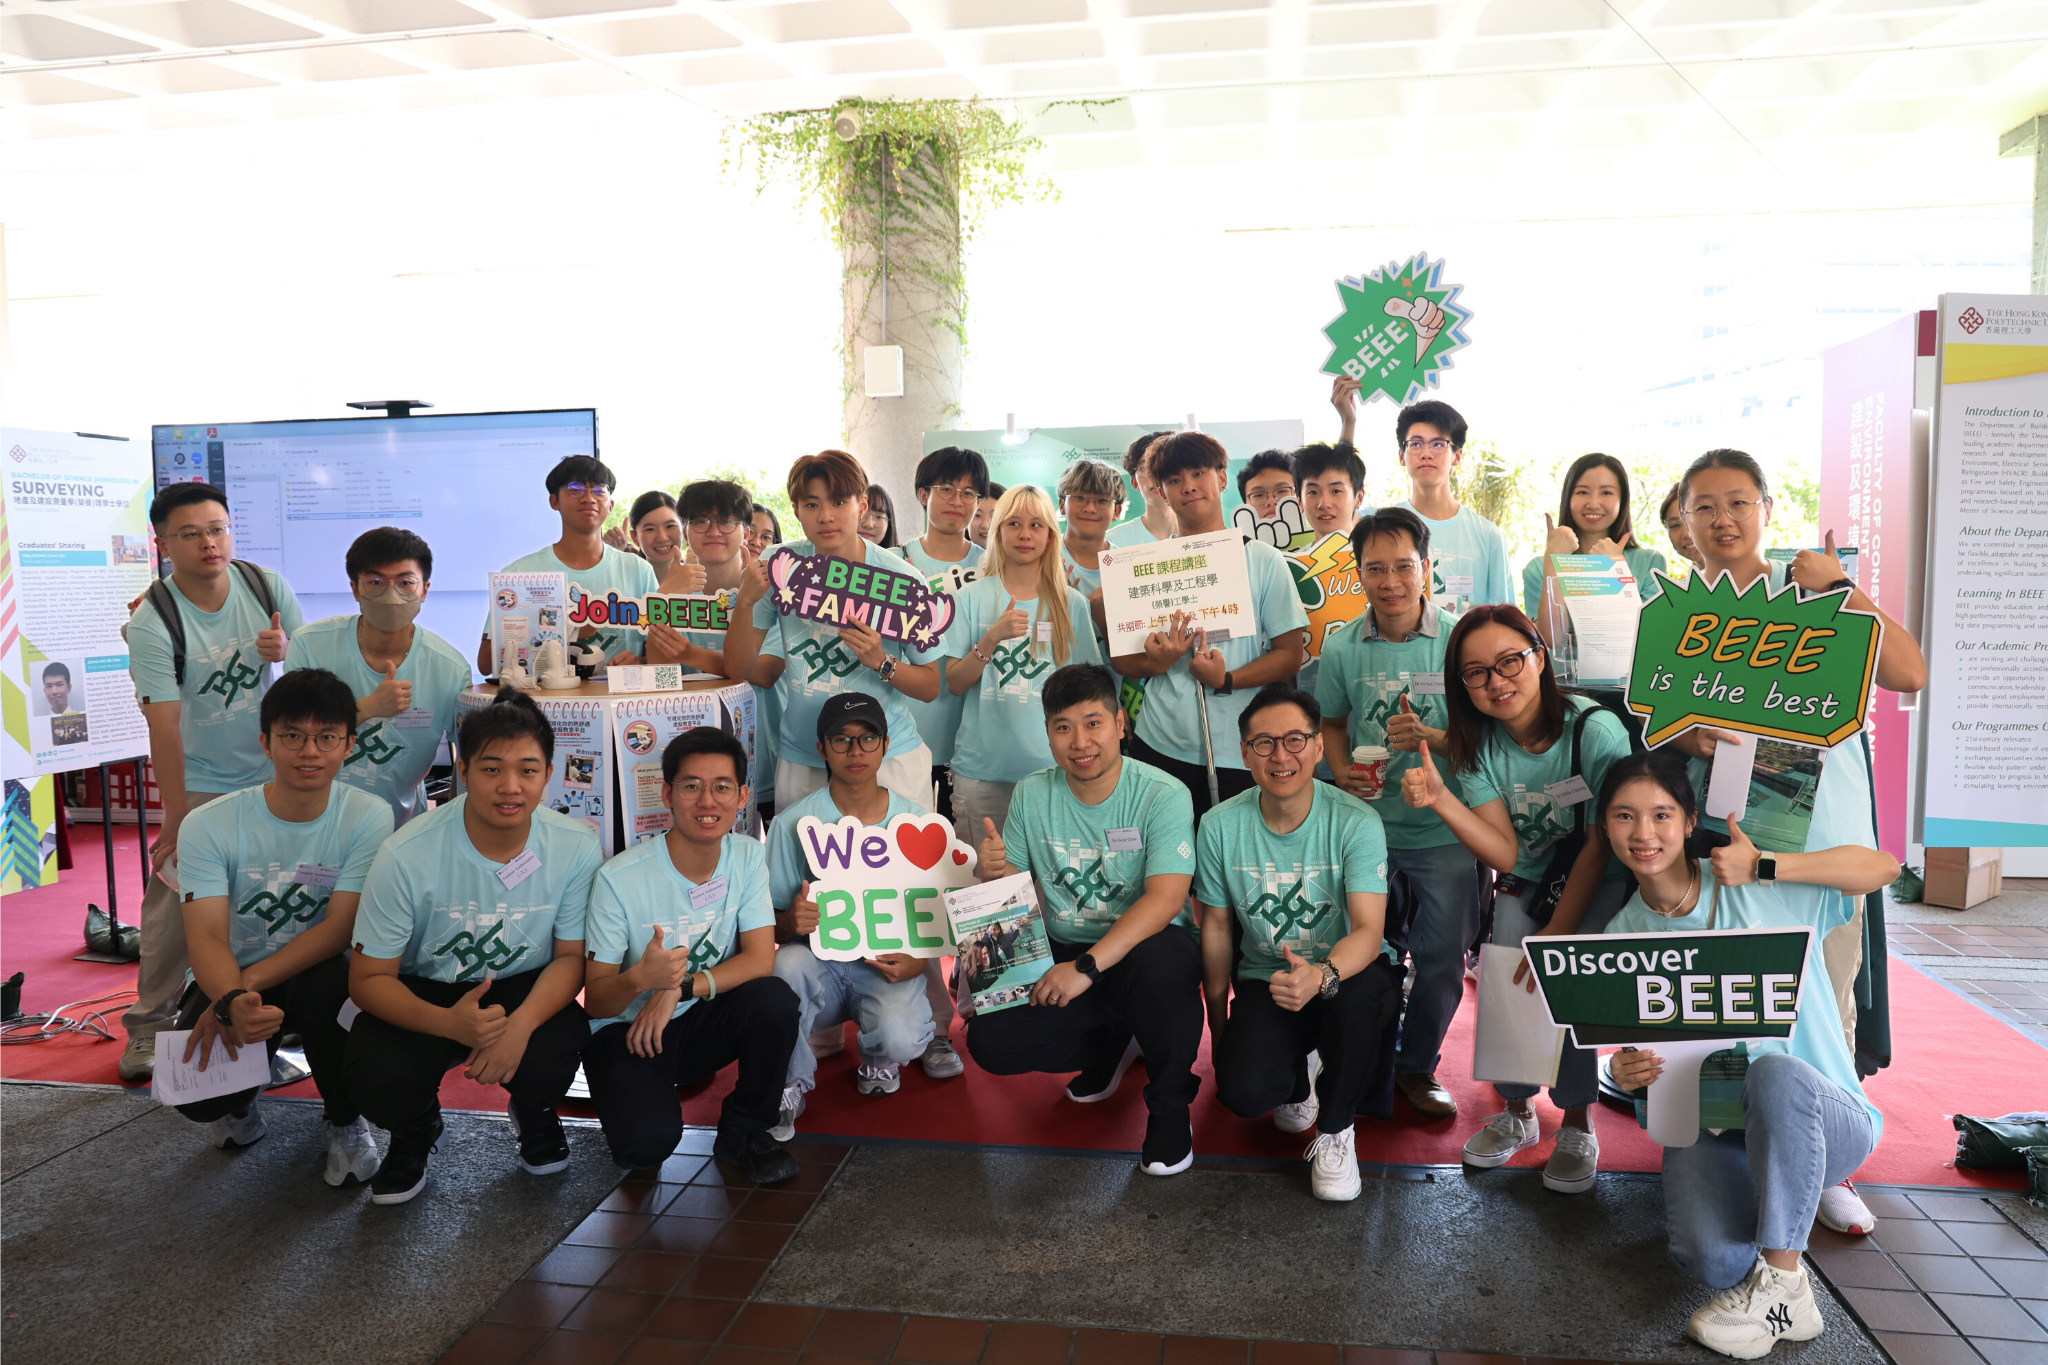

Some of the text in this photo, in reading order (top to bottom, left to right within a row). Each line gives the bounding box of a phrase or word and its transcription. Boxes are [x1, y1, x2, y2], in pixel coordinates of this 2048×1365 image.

[1986, 318, 2042, 326] POLYTECHNIC
[1341, 320, 1409, 381] BEEE
[1965, 406, 2043, 418] Introduction to
[1873, 392, 1884, 528] FACULTY OF
[12, 481, 104, 497] SURVEYING
[1861, 395, 1874, 558] ENVIRONMENT
[1959, 526, 2011, 536] About the
[1134, 562, 1154, 577] BEEE
[1157, 554, 1208, 575] 課程講座
[825, 560, 911, 606] BEEE
[1128, 573, 1218, 600] 建築科學及工程學
[1329, 573, 1366, 597] We
[1957, 588, 2045, 601] Learning In BEEE
[569, 592, 729, 630] Join BEEE
[800, 587, 920, 640] FAMILY
[1152, 594, 1198, 610] (榮譽)工學士
[1117, 619, 1146, 633] 共兩節:
[1148, 615, 1167, 629] 上午
[1199, 607, 1219, 620] 下午
[1676, 613, 1837, 674] BEEE
[1955, 640, 2030, 650] Our Academic
[1649, 665, 1840, 719] is the best
[1952, 721, 2039, 733] Our Programmes
[807, 825, 890, 870] We
[1542, 946, 1699, 977] Discover
[1636, 973, 1798, 1025] BEEE
[1766, 1302, 1793, 1337] NY
